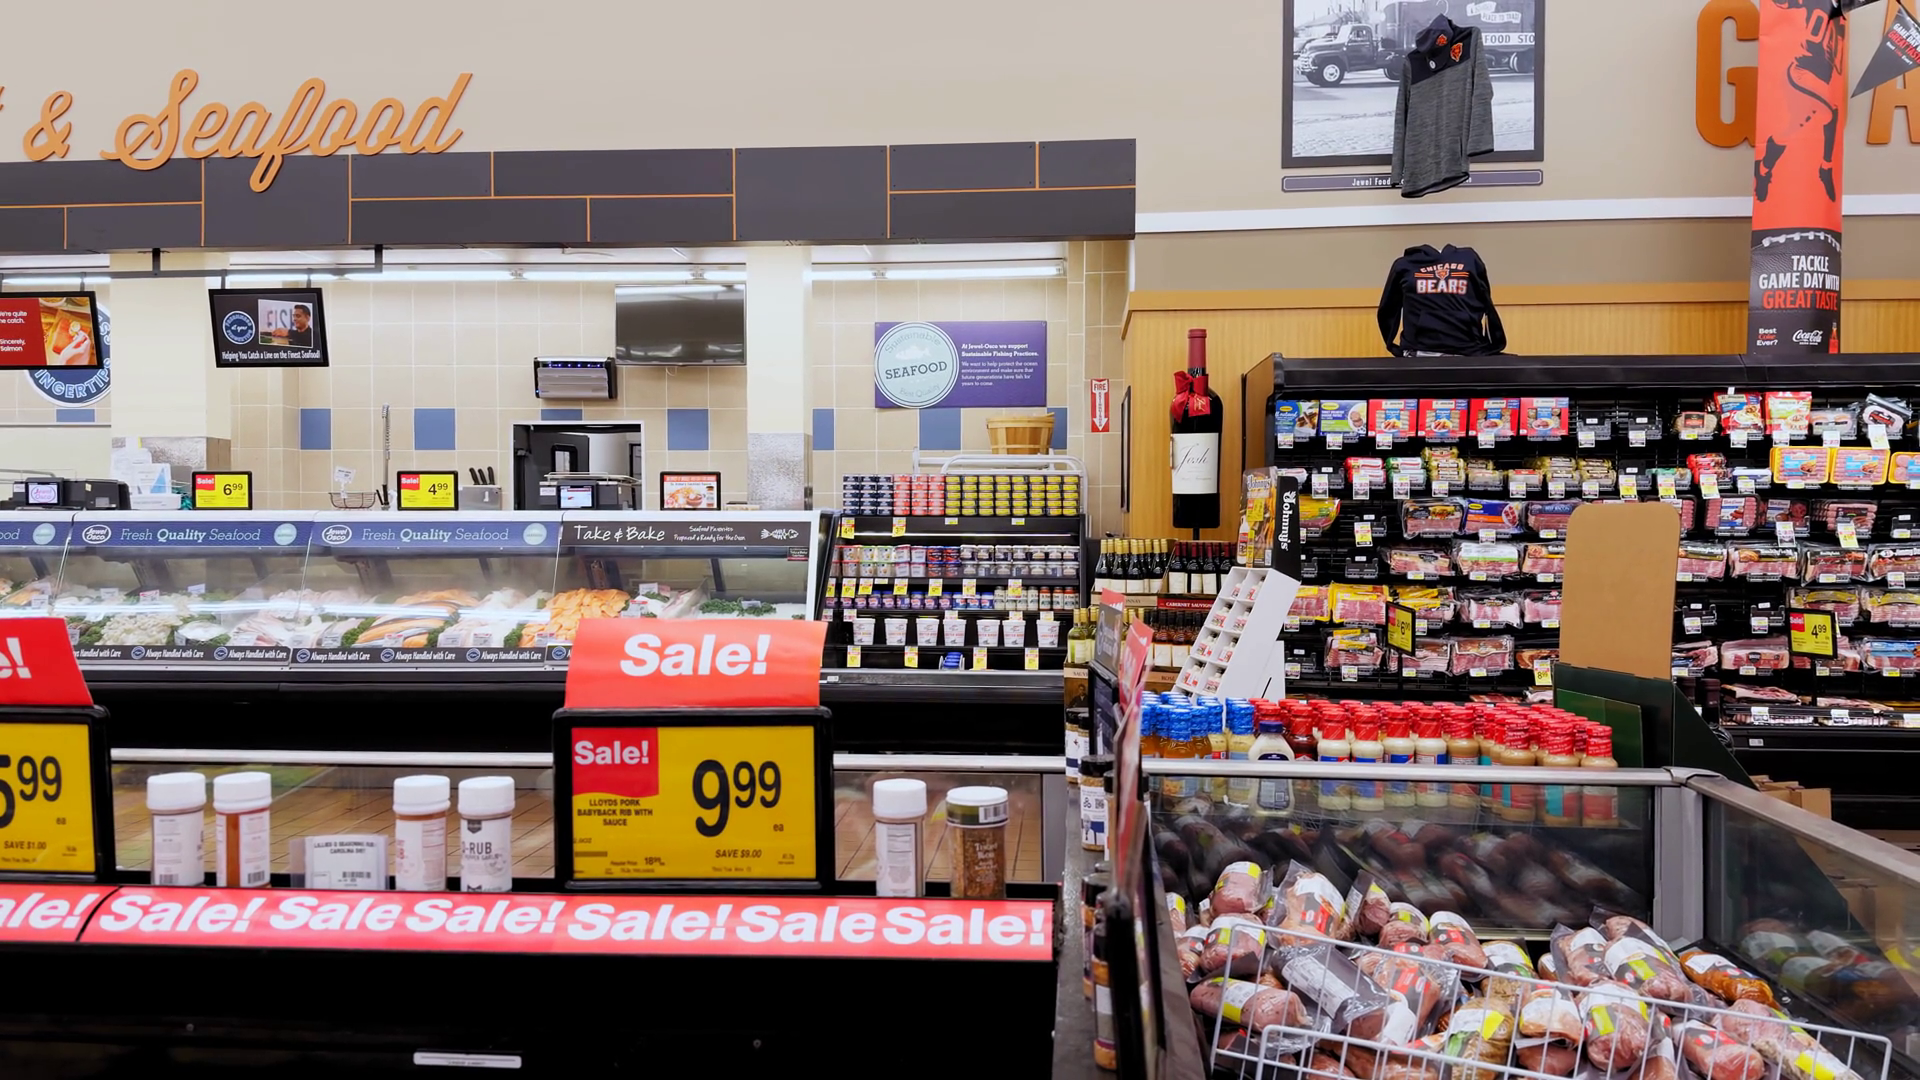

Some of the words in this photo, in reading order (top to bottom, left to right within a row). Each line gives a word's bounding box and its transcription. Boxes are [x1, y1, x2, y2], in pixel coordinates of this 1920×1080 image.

[1484, 34, 1511, 44] FOOD
[23, 90, 73, 162] &
[100, 68, 473, 193] Seafood
[1352, 177, 1372, 187] Jewel
[1374, 177, 1391, 186] Food
[1420, 263, 1465, 273] CHICAGO
[1791, 255, 1829, 272] TACKLE
[1416, 278, 1468, 295] BEARS
[1758, 272, 1800, 289] GAME
[1803, 272, 1824, 289] DAY
[1825, 273, 1840, 291] WITH
[1762, 289, 1813, 309] GREAT
[1815, 290, 1838, 311] TASTE
[884, 330, 941, 354] Sustainable
[222, 351, 239, 361] Helping
[239, 351, 247, 359] You
[247, 351, 260, 359] Catch
[264, 351, 273, 359] Line
[279, 351, 287, 359] the
[287, 350, 301, 359] Finest
[301, 350, 320, 359] Seafood!
[885, 360, 948, 380] SEAFOOD
[1094, 383, 1107, 391] FIRE
[1176, 443, 1211, 475] Josh
[1278, 490, 1297, 552] Johnny's
[86, 527, 107, 535] Jewel
[120, 528, 153, 541] Fresh
[156, 527, 207, 543] Quality
[209, 528, 261, 541] Seafood
[326, 527, 348, 535] Jewel
[362, 528, 395, 541] Fresh
[400, 528, 451, 543] Quality
[455, 528, 509, 540] Seafood
[574, 525, 611, 541] Take
[613, 528, 623, 542] &
[626, 526, 665, 541] Bake
[326, 533, 347, 541] Osco
[700, 533, 716, 543] Ready
[79, 648, 99, 657] Handled
[99, 648, 110, 657] with
[110, 649, 121, 657] Care
[145, 649, 162, 660] Always
[162, 649, 181, 658] Handled
[181, 649, 193, 658] with
[193, 650, 204, 658] Care
[228, 650, 244, 660] Always
[244, 650, 264, 658] Handled
[264, 650, 276, 659] with
[276, 651, 287, 659] Care
[310, 651, 327, 662] Always
[327, 651, 347, 661] Handled
[347, 651, 359, 660] with
[359, 652, 370, 660] Care
[394, 651, 412, 662] Always
[412, 651, 432, 661] Handled
[432, 651, 444, 660] with
[444, 651, 456, 660] Care
[481, 651, 498, 662] Always
[498, 651, 518, 661] Handled
[518, 651, 530, 660] with
[530, 651, 542, 660] Care
[620, 633, 771, 677] Sale!
[574, 740, 649, 765] Sale!
[577, 808, 617, 816] BABYBACK
[56, 817, 67, 825] ea
[603, 818, 627, 826] SAUCE
[773, 823, 784, 832] ea
[4, 840, 25, 849] SAVE
[27, 841, 47, 850] $1.00
[715, 849, 738, 858] SAVE
[740, 849, 762, 858] $9.00
[99, 895, 267, 932] Sale!
[269, 896, 403, 931] Sale
[405, 899, 567, 934] Sale!
[567, 902, 734, 941] Sale!
[735, 904, 877, 943] Sale
[881, 906, 1045, 945] Sale!
